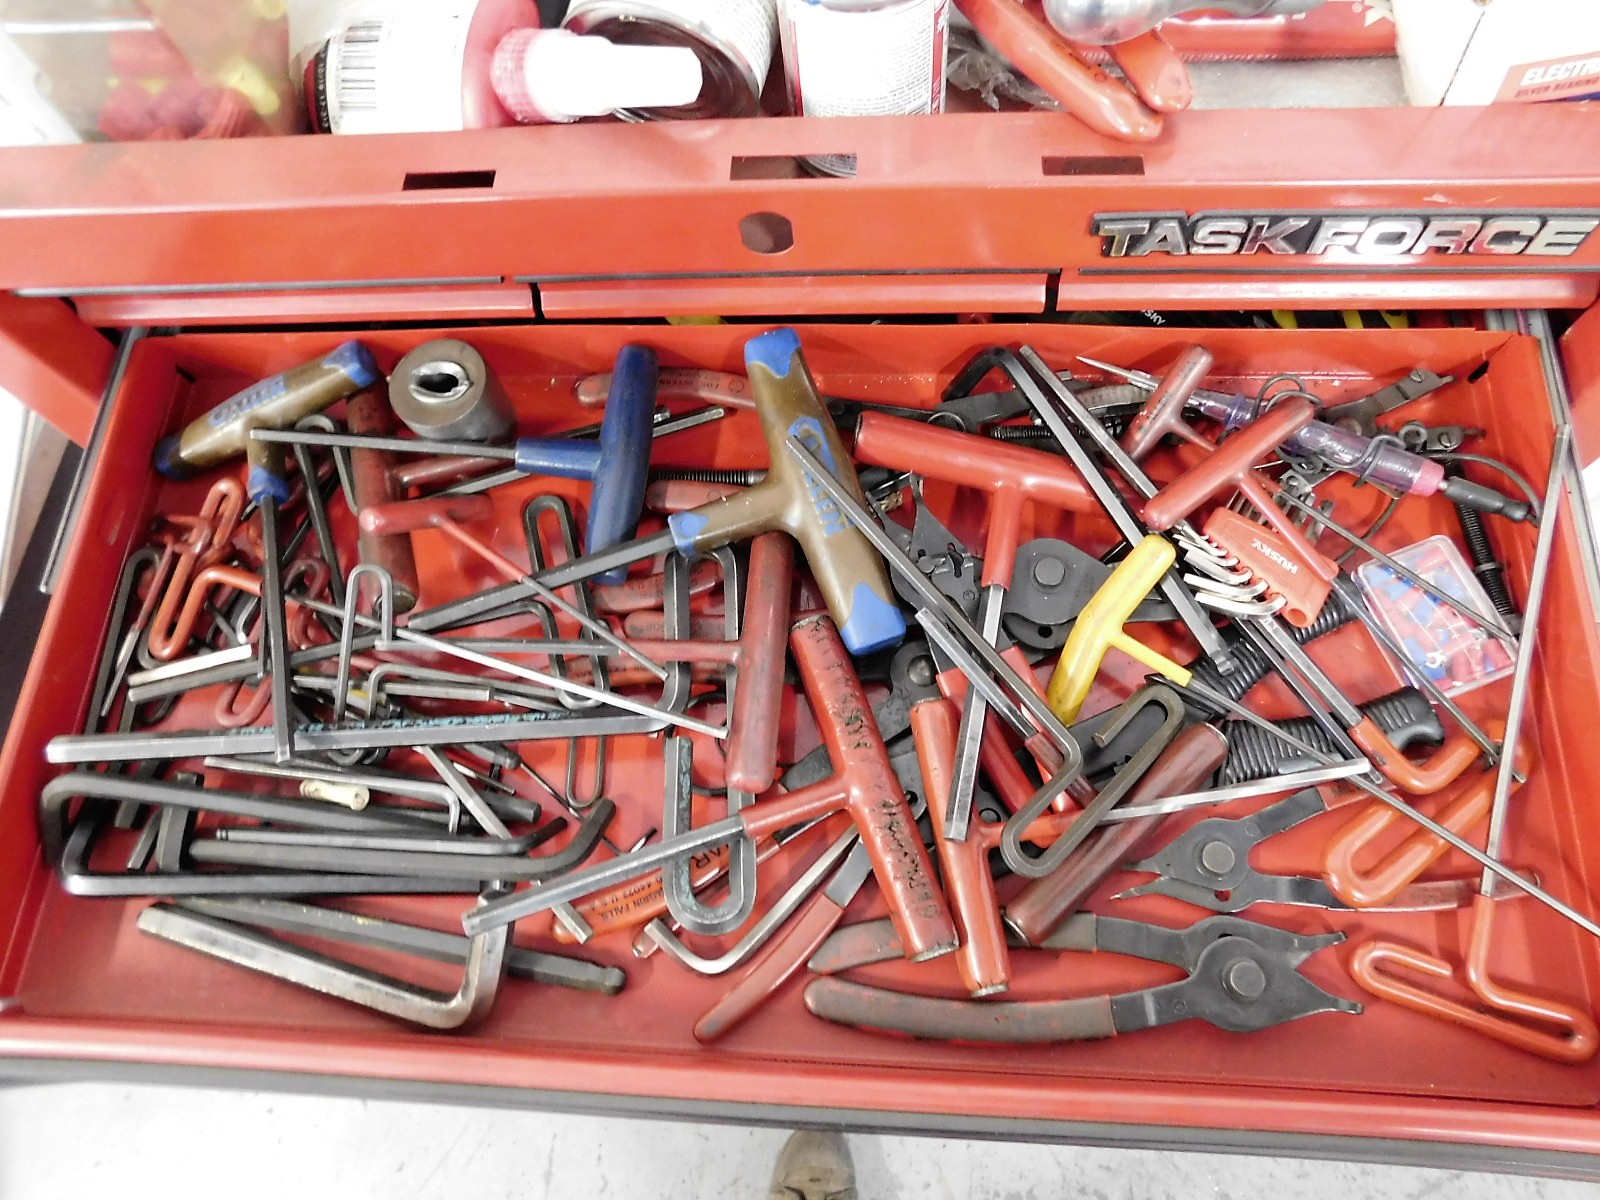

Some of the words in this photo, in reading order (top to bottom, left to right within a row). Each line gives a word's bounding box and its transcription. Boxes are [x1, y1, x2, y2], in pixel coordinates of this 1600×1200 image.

[1098, 216, 1308, 257] TASK
[1308, 216, 1599, 257] FORCE
[1140, 309, 1166, 325] SKY
[1250, 537, 1299, 575] HUSKY
